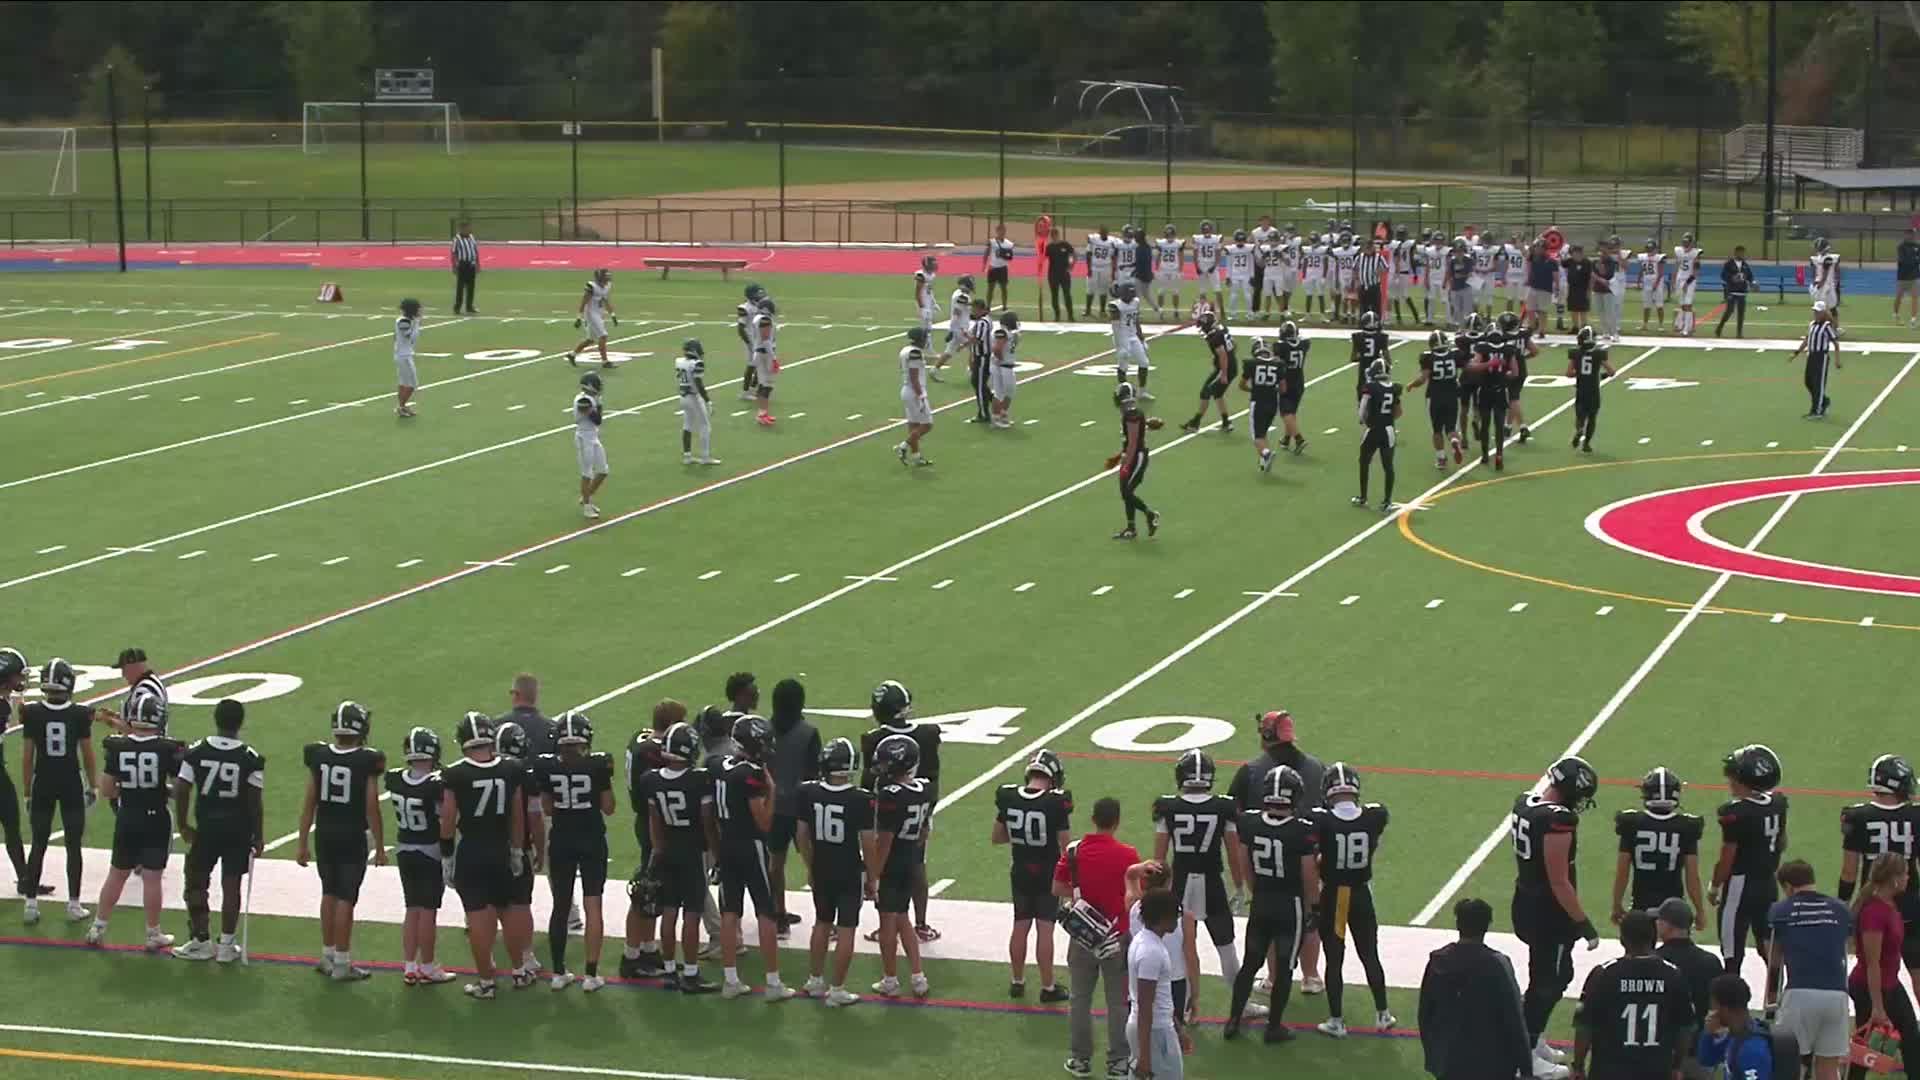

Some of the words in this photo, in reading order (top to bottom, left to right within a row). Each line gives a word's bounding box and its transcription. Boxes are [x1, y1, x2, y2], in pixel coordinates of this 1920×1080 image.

[1289, 350, 1305, 370] 51
[1362, 338, 1376, 357] 3
[1581, 356, 1594, 375] 6
[1254, 364, 1278, 386] 65
[1432, 359, 1456, 380] 53
[1380, 393, 1394, 415] 2
[46, 721, 67, 757] 8
[119, 752, 160, 789] 58
[200, 759, 241, 798] 79
[320, 763, 351, 804] 19
[472, 778, 506, 817] 71
[550, 774, 593, 810] 32
[655, 790, 691, 827] 12
[715, 778, 730, 820] 11
[813, 802, 845, 845] 16
[1006, 808, 1048, 847] 20
[1173, 814, 1218, 853] 27
[1764, 814, 1780, 852] 4
[1866, 821, 1915, 860] 34
[1252, 835, 1286, 879] 21
[1335, 831, 1370, 870] 18
[1634, 830, 1682, 872] 24
[1620, 979, 1665, 993] BROWN
[1621, 1003, 1661, 1047] 11
